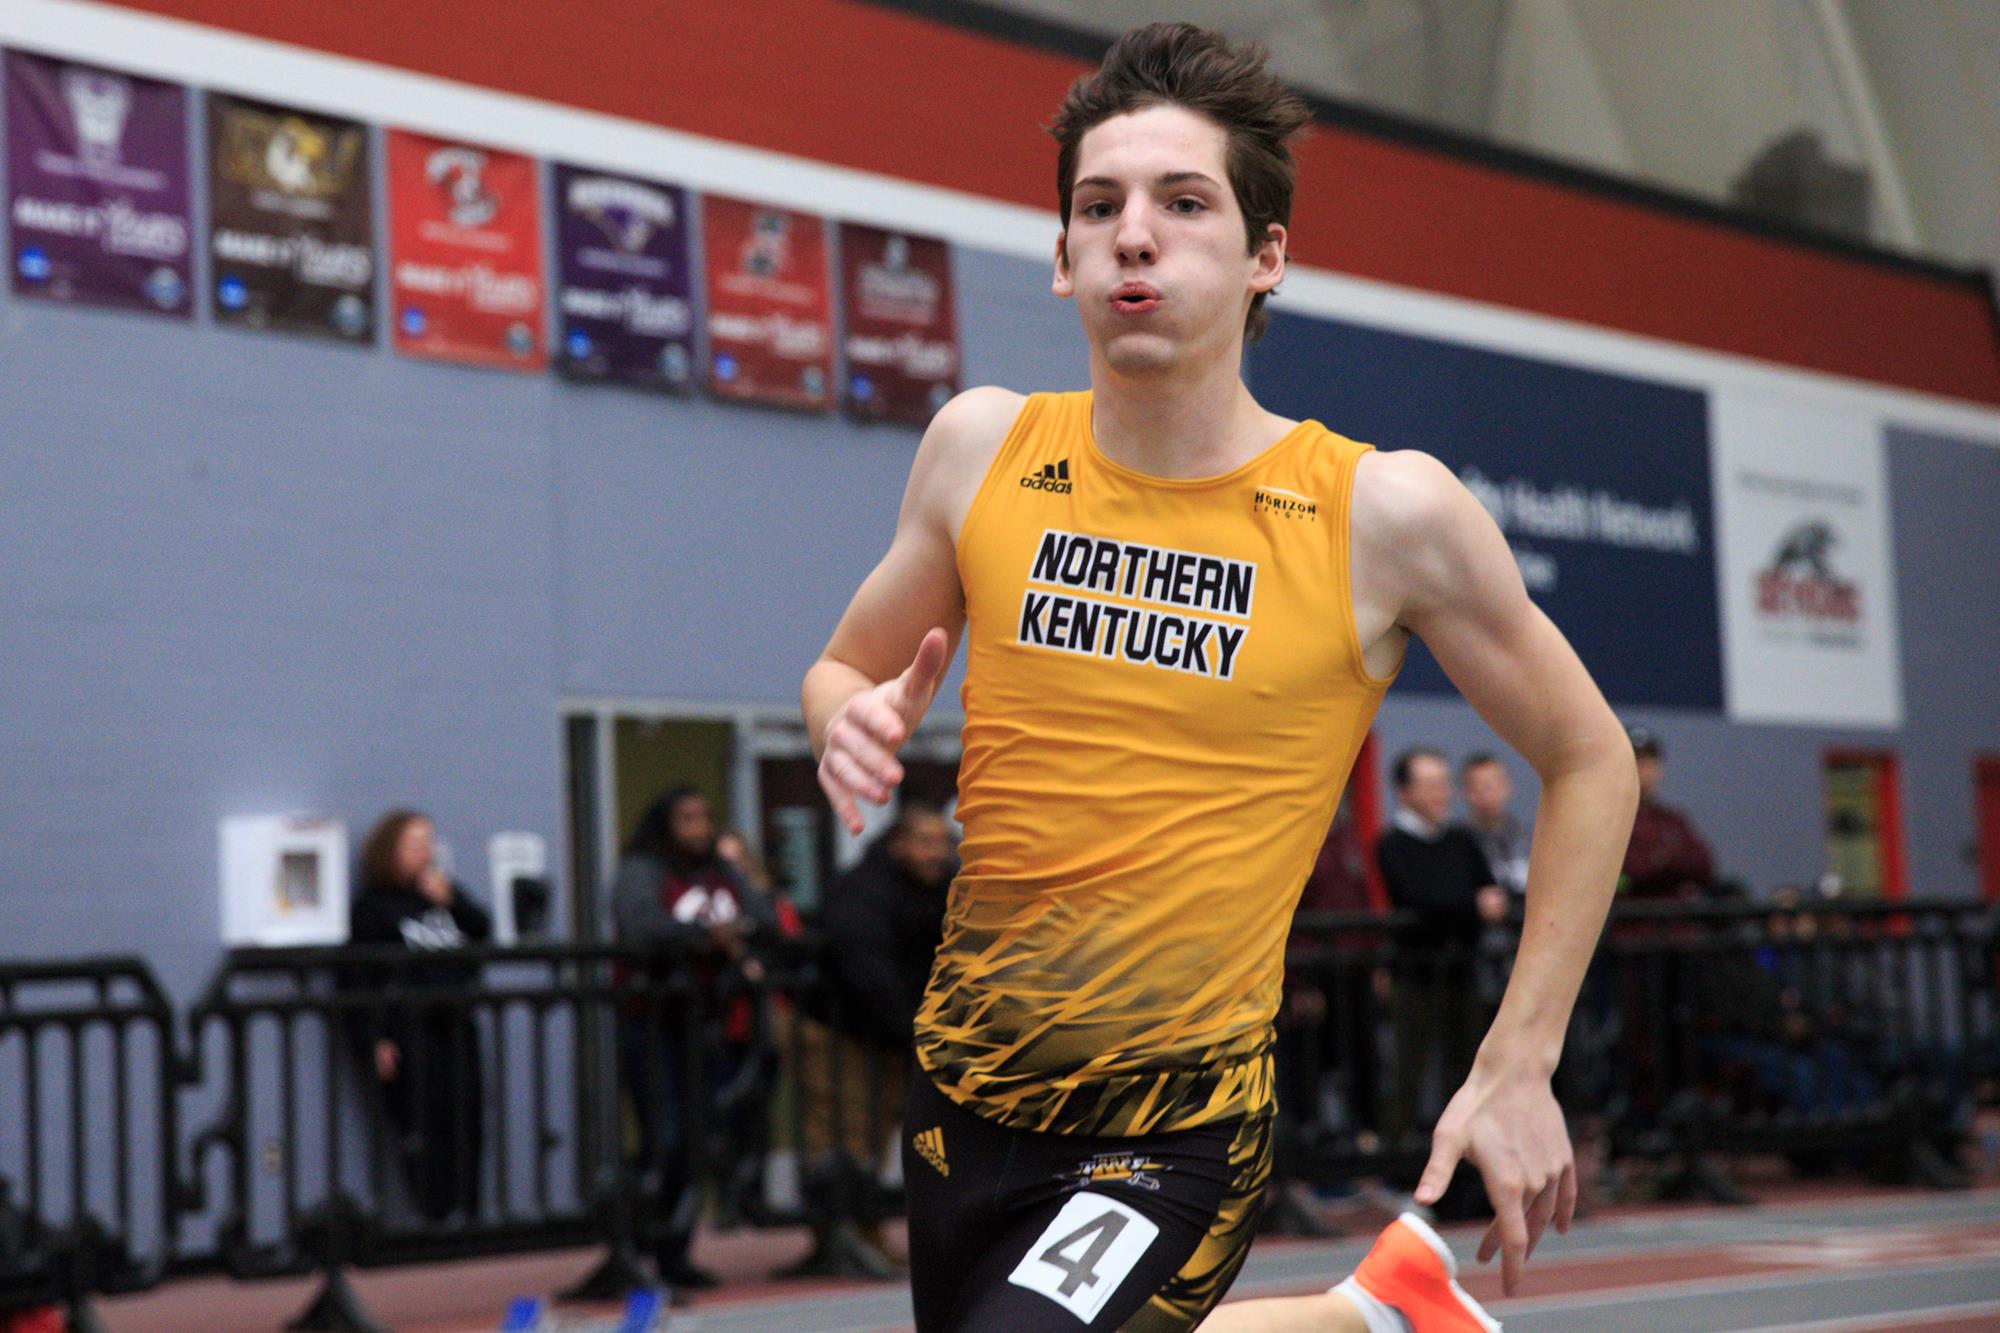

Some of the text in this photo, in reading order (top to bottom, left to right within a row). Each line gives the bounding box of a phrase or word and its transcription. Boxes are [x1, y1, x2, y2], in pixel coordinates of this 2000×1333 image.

[1020, 477, 1072, 494] addas
[1254, 491, 1316, 515] HORIZON
[1031, 532, 1254, 616] NORTHERN
[1019, 592, 1245, 679] KENTUCKY
[1039, 1208, 1131, 1299] 4
